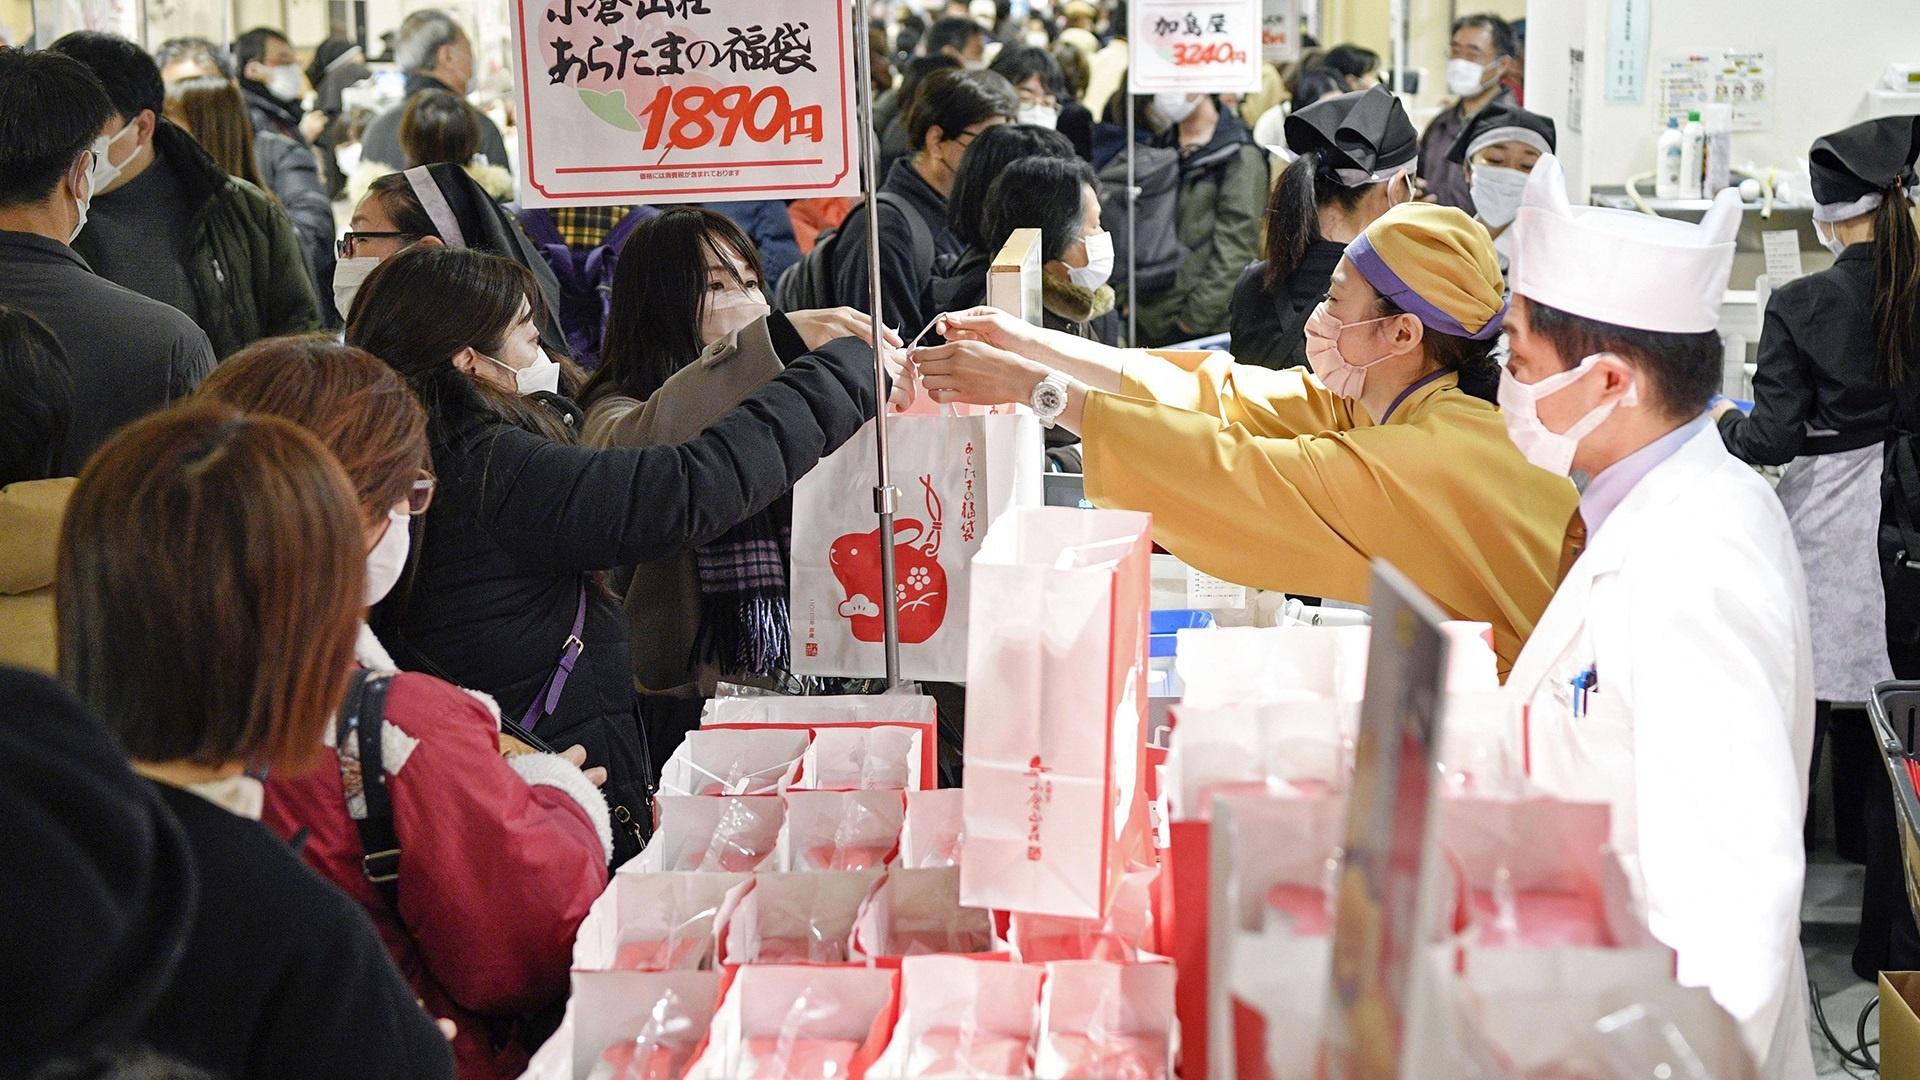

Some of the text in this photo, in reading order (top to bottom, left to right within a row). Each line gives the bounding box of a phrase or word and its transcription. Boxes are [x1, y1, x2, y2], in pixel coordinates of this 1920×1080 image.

[1155, 12, 1228, 36] 加島屋
[548, 22, 817, 86] あらたまの福袋
[640, 169, 740, 180] 価格には消費税が含まれております
[961, 441, 976, 542] あらたまの福袋
